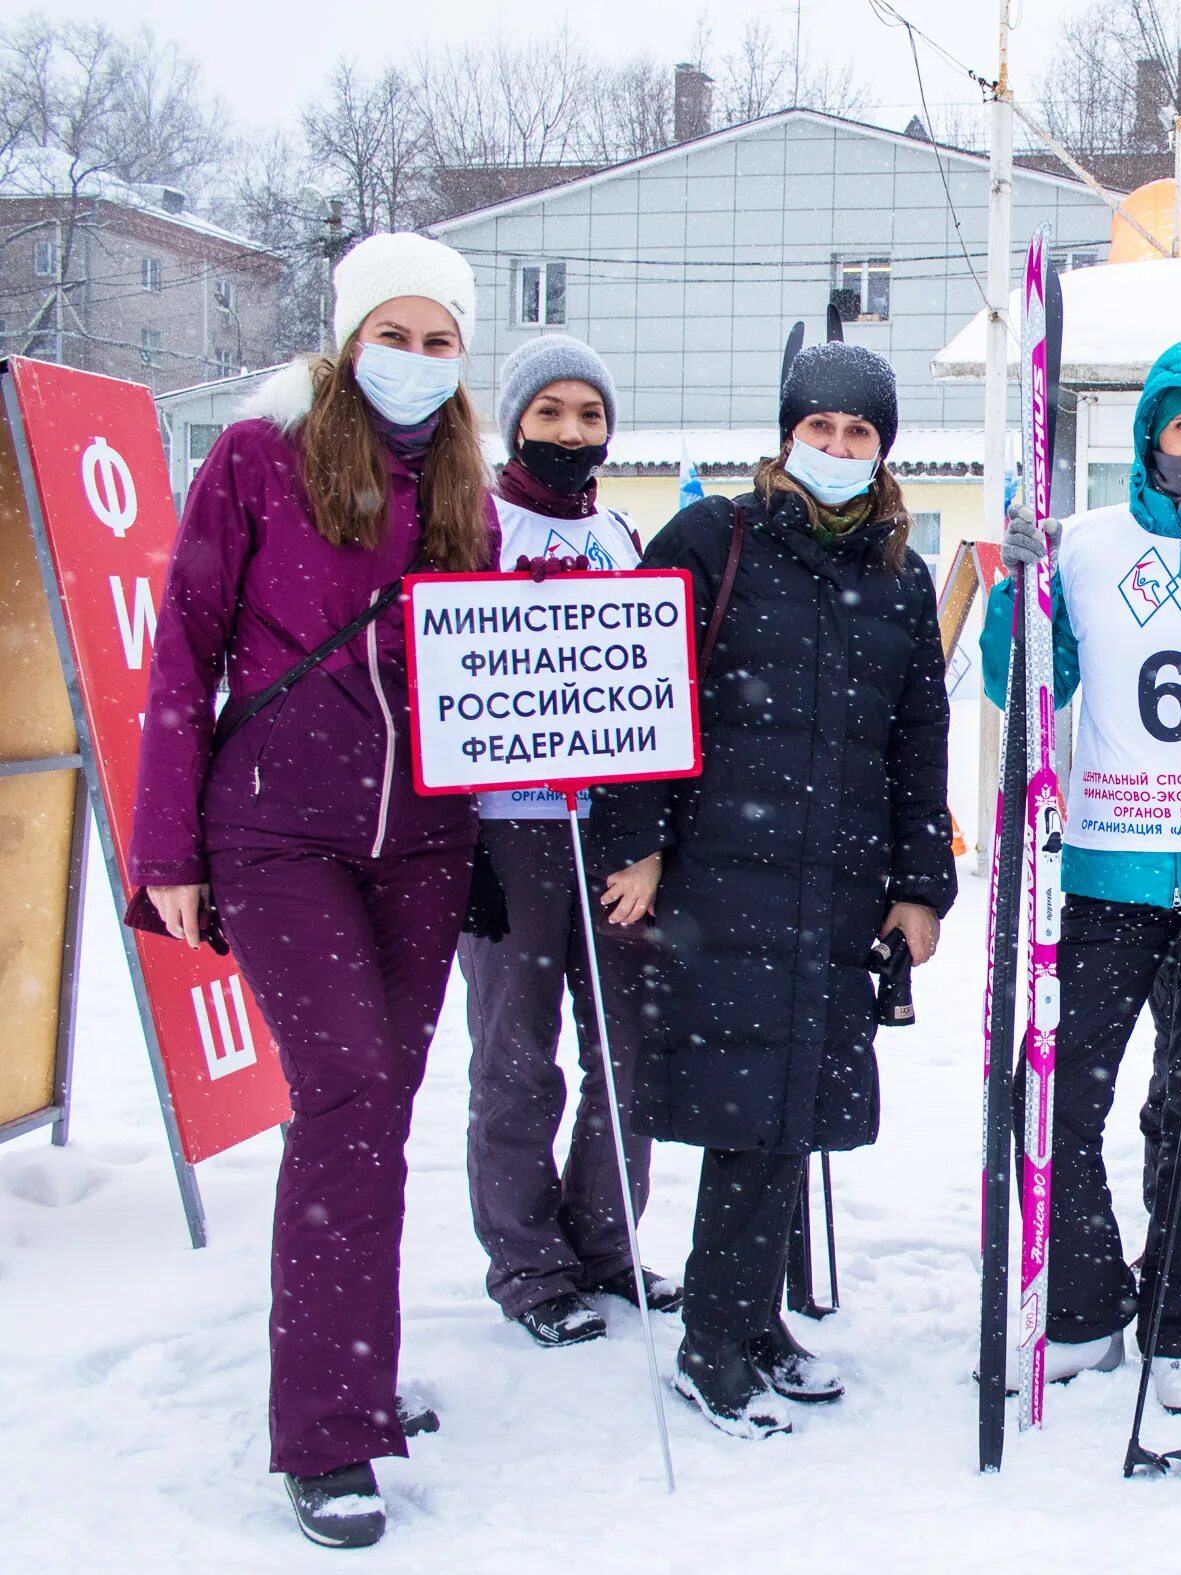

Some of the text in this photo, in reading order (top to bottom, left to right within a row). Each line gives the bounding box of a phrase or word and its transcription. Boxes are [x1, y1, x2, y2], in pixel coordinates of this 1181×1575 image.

[422, 601, 679, 635] МИНИСТЕРСТВО
[461, 644, 648, 676] ФИНАНСОВ
[438, 677, 675, 721] РОССИЙСКОЙ
[461, 725, 657, 764] ФЕДЕРАЦИИ
[1082, 771, 1149, 786] ЦЕНТРАЛЬНЫЙ
[1081, 819, 1163, 835] ОРГАНИЗАЦИЯ
[1113, 806, 1172, 819] ОРГАНОВ
[1031, 1173, 1047, 1264] Amica 90
[1025, 1312, 1035, 1330] 190
